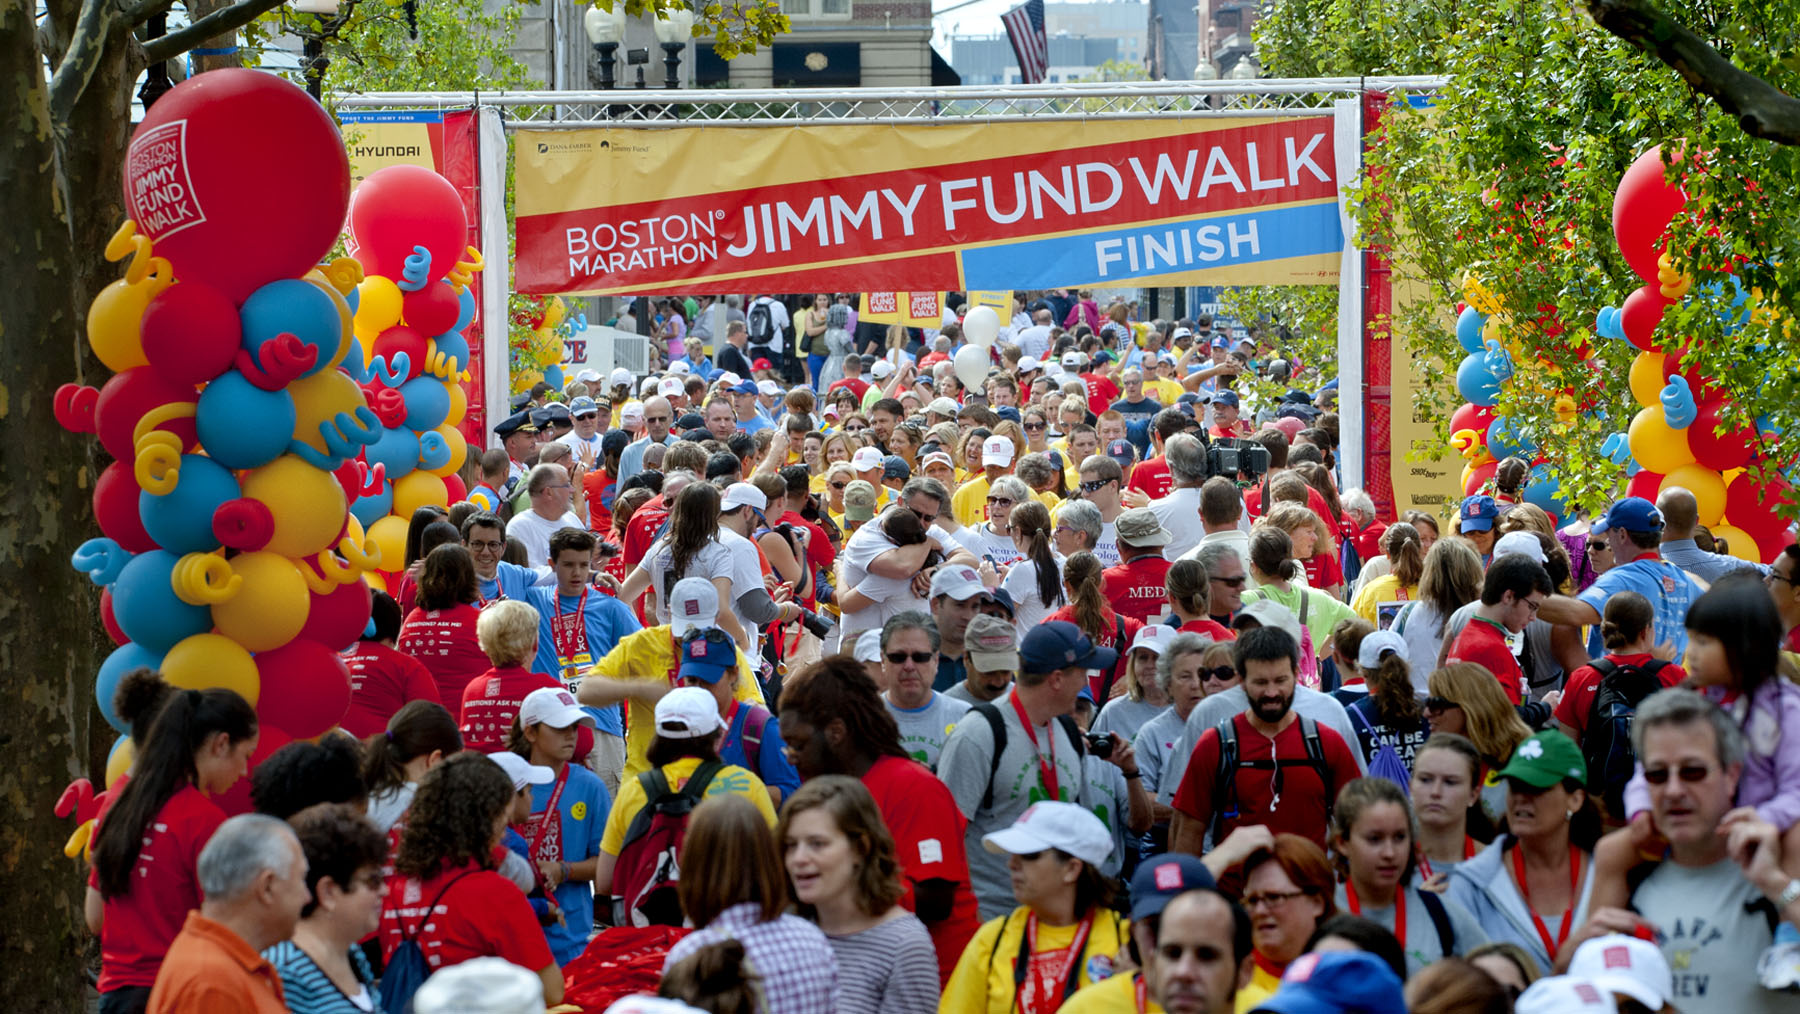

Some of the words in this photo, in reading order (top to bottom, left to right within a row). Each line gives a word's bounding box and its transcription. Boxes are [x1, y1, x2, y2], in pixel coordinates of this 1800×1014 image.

[132, 140, 177, 165] BOSTON
[355, 146, 420, 157] HYUNDAI
[135, 163, 178, 198] JIMMY
[137, 183, 184, 218] FUND
[726, 184, 927, 257] JIMMY
[940, 162, 1123, 231] FUND
[1128, 133, 1332, 205] WALK
[143, 200, 194, 234] WALK
[1094, 219, 1260, 277] FINISH
[568, 240, 718, 277] MARATHON
[871, 297, 895, 305] FUND
[911, 302, 937, 310] FUND
[871, 304, 896, 312] WALK
[912, 309, 937, 317] WALK
[1097, 551, 1118, 562] olog
[1128, 587, 1167, 598] MED
[464, 700, 496, 708] QUESTIONS?
[1370, 735, 1400, 748] CAN
[1405, 731, 1424, 744] BE
[539, 845, 559, 857] ND
